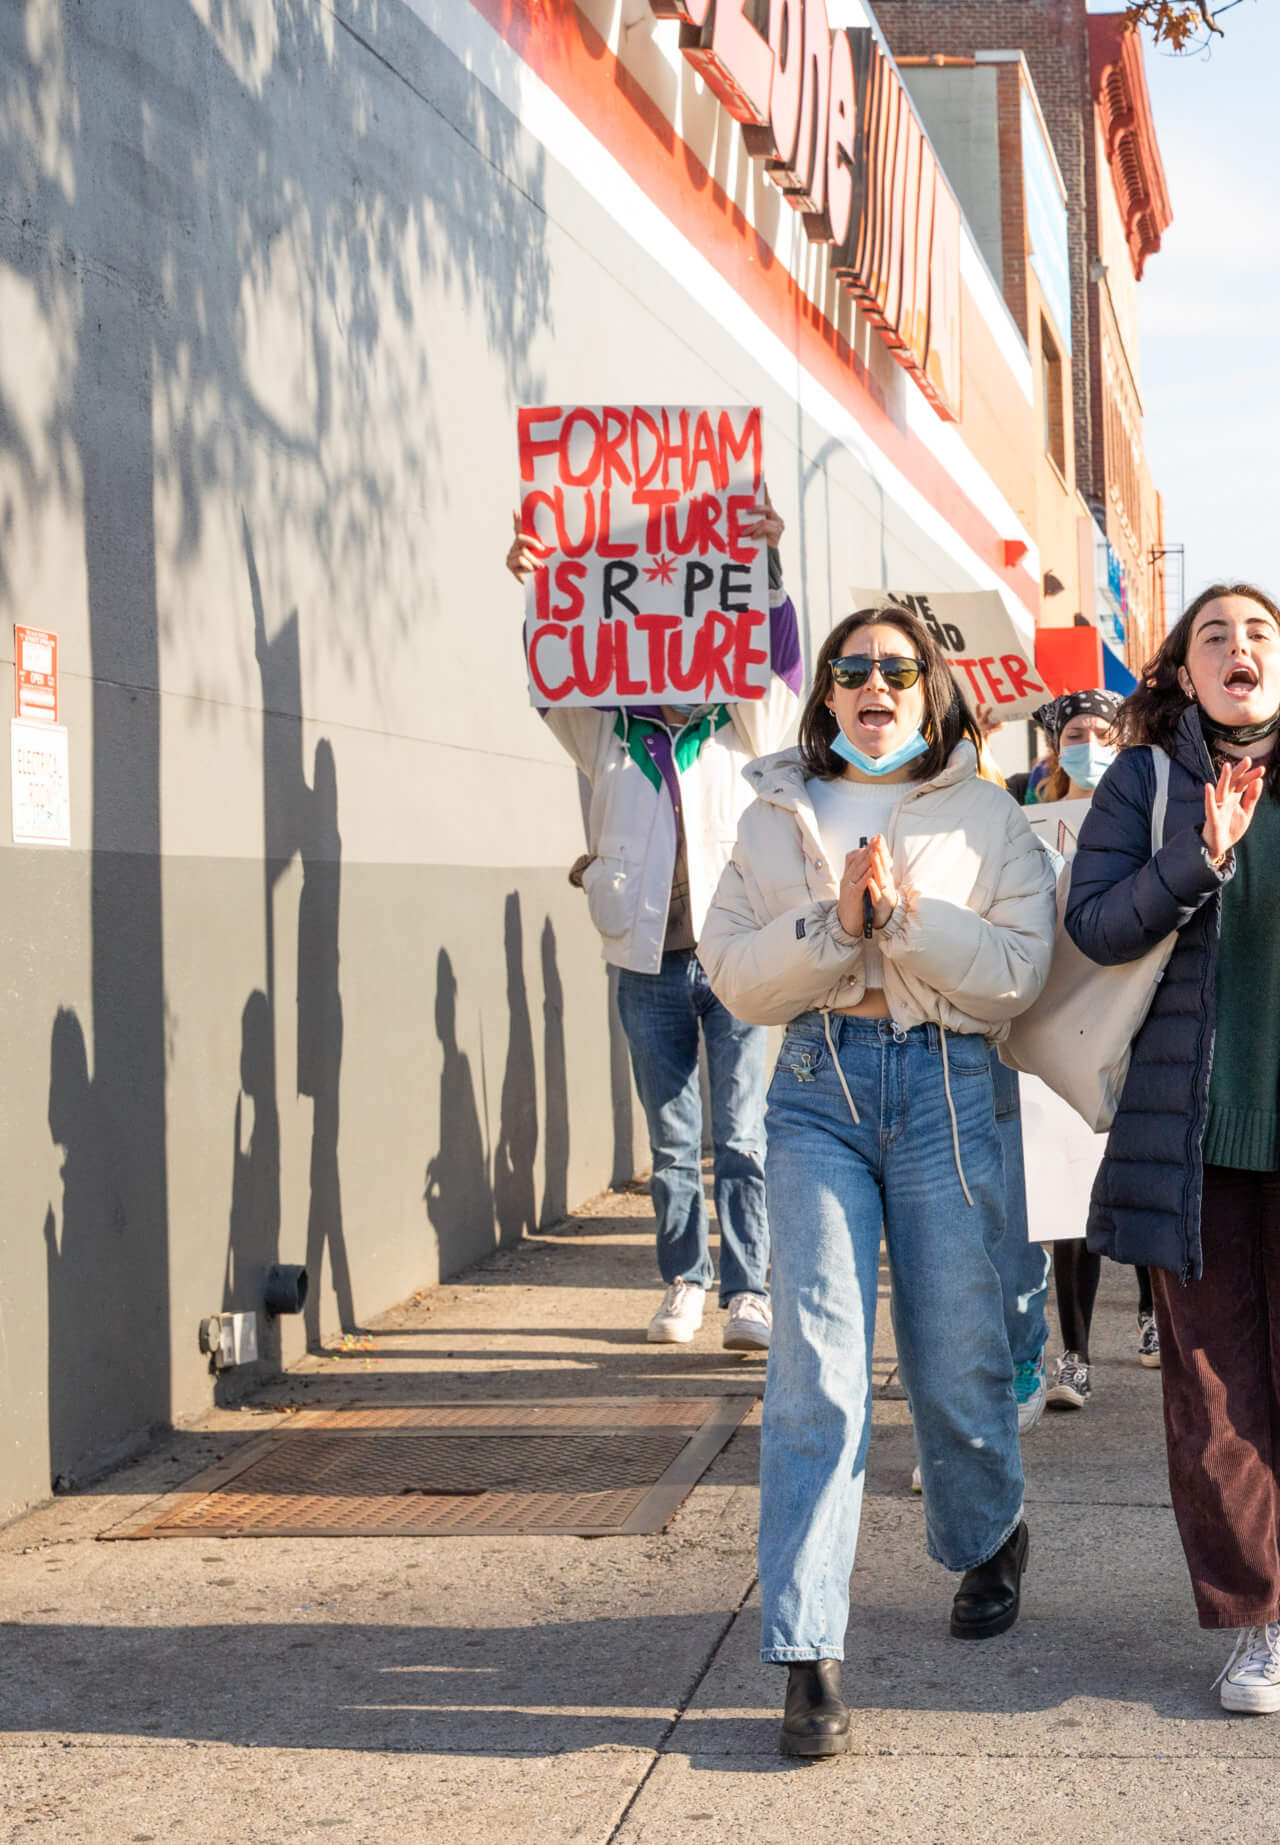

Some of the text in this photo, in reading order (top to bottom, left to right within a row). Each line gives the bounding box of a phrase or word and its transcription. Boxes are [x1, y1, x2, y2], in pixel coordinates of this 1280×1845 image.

[518, 406, 762, 493] FORDHAM
[521, 485, 759, 564] CULTURE
[534, 560, 588, 622] IS
[528, 609, 768, 703] CULTURE
[926, 622, 966, 653] ND
[946, 654, 1044, 704] TER
